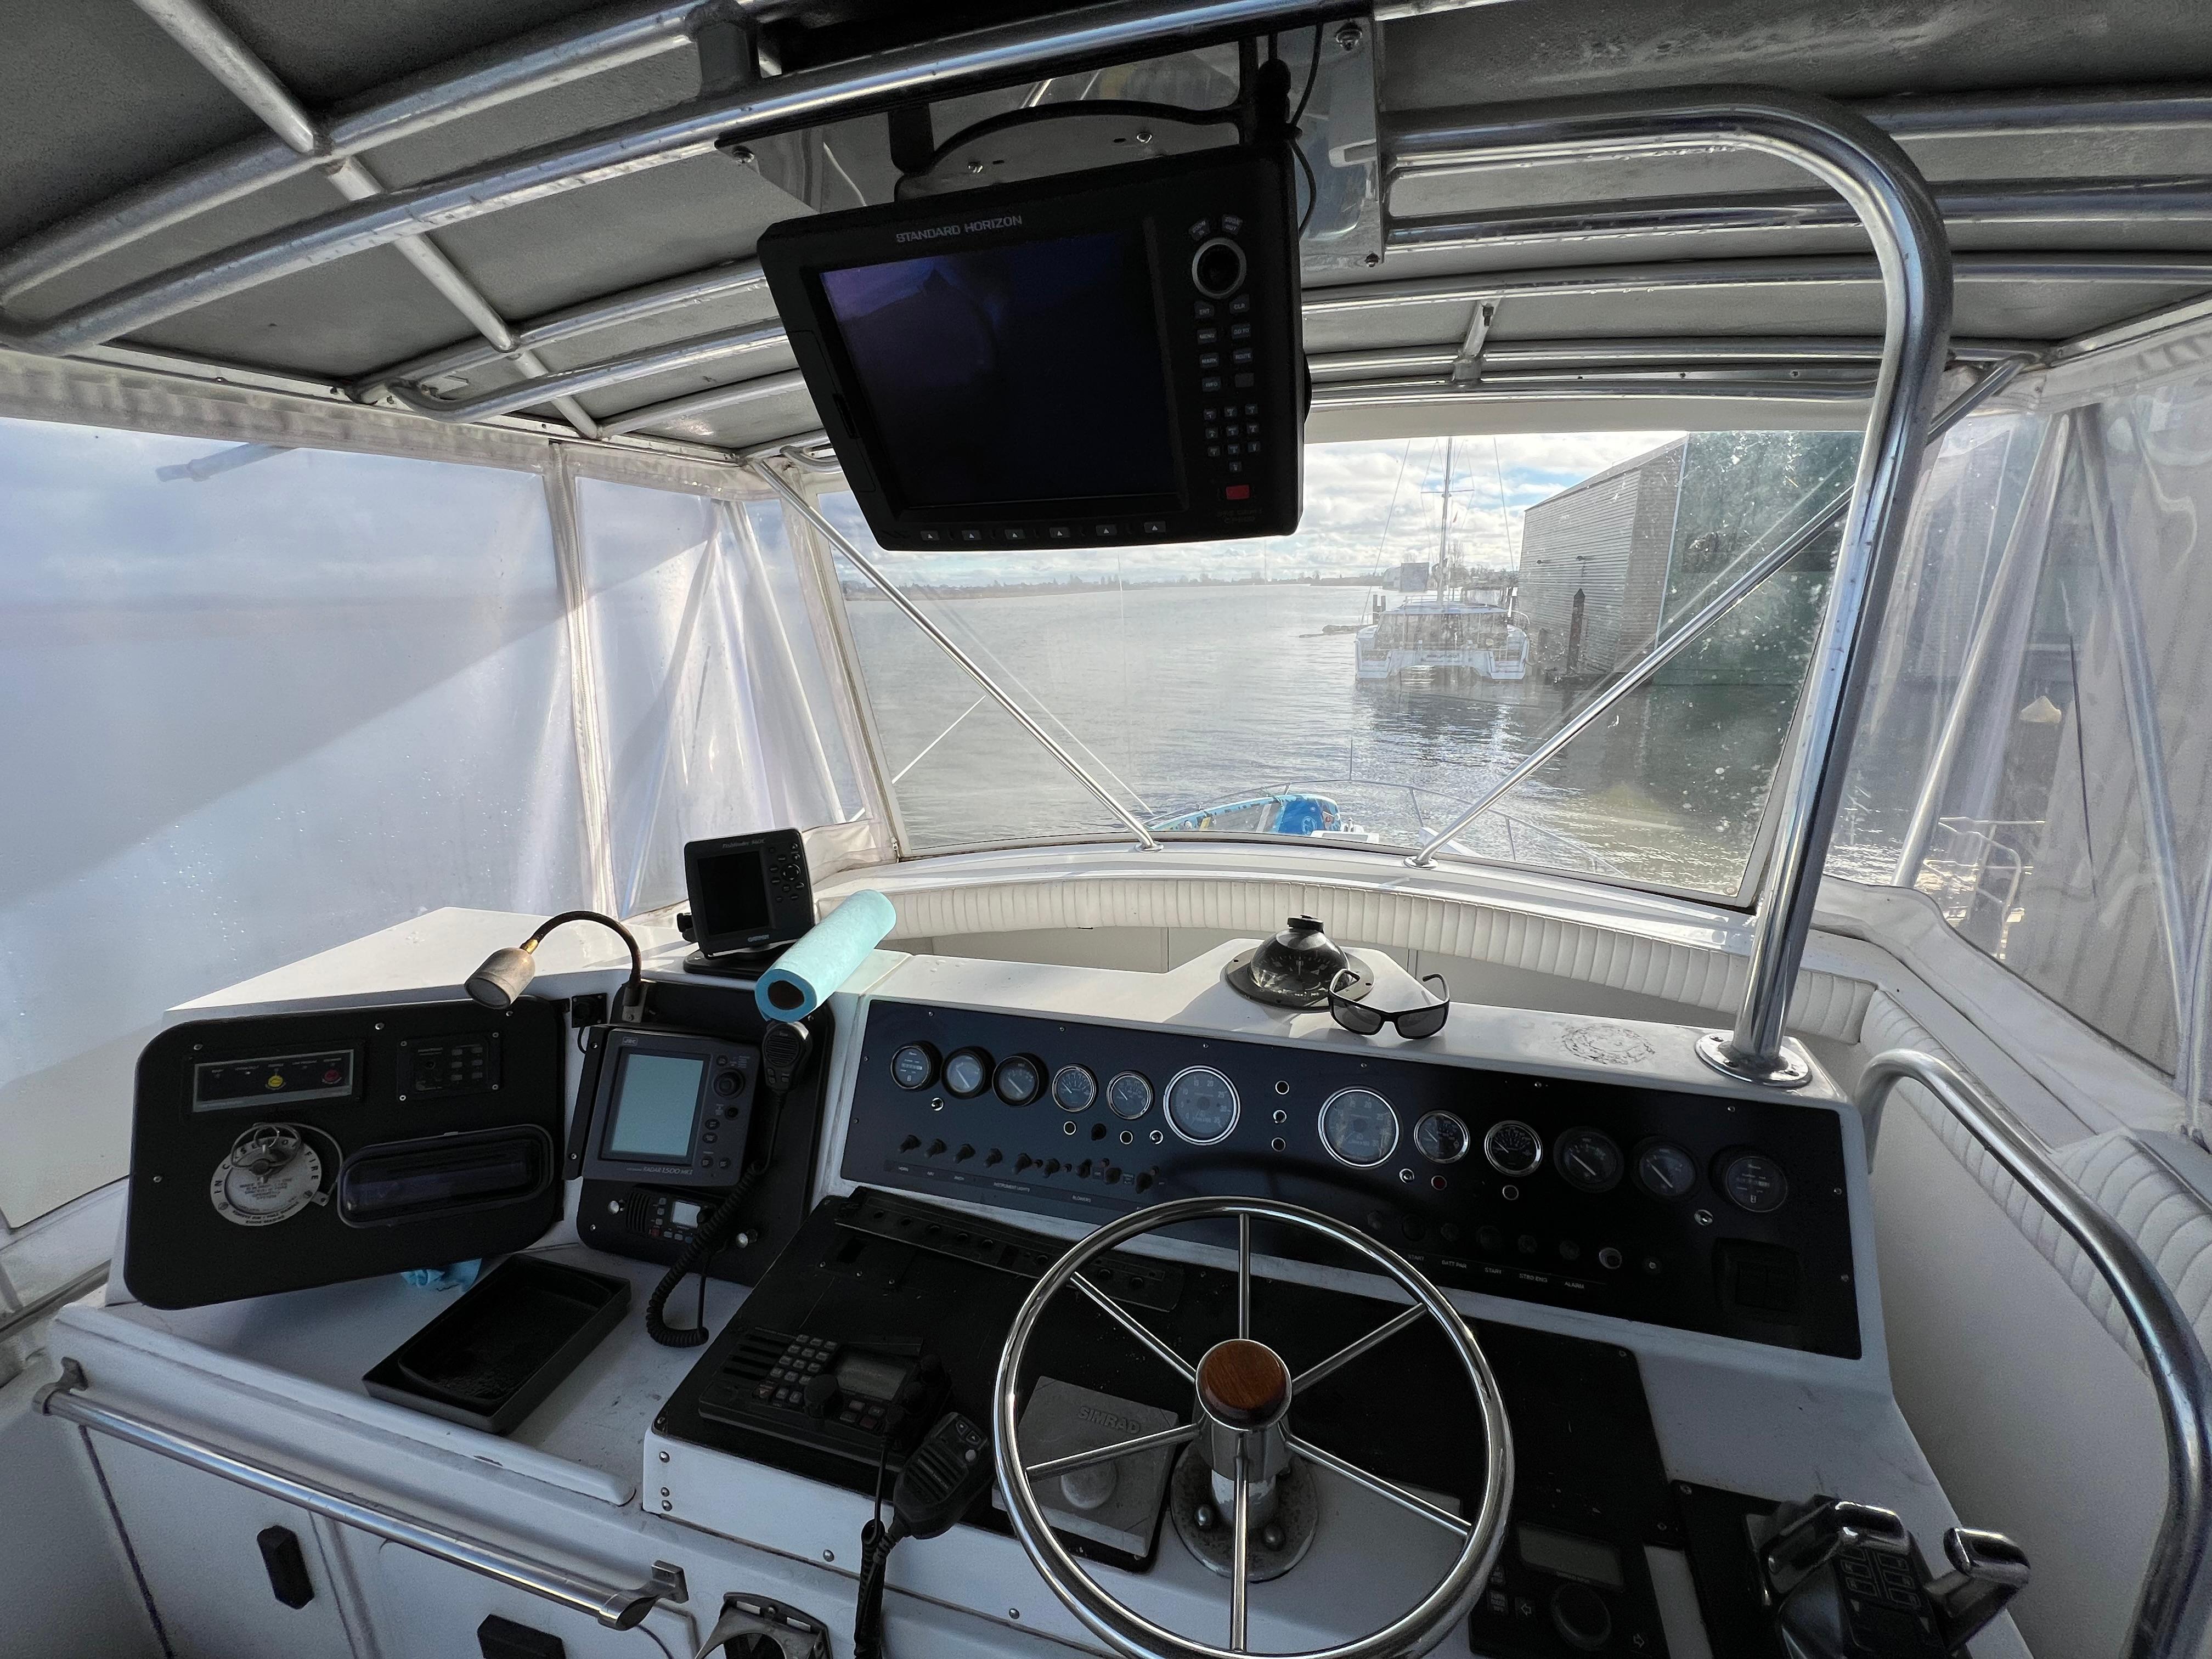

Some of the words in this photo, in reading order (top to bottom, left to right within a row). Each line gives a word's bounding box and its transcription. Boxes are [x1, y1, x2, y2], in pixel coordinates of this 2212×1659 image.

[896, 225, 961, 242] STANDARD
[964, 215, 1023, 233] HORIZON
[304, 1150, 319, 1180] FIRE
[994, 1182, 1017, 1190] INSTRUMENT
[1564, 1281, 1585, 1290] ALARM
[1079, 1406, 1141, 1435] SIMRAD
